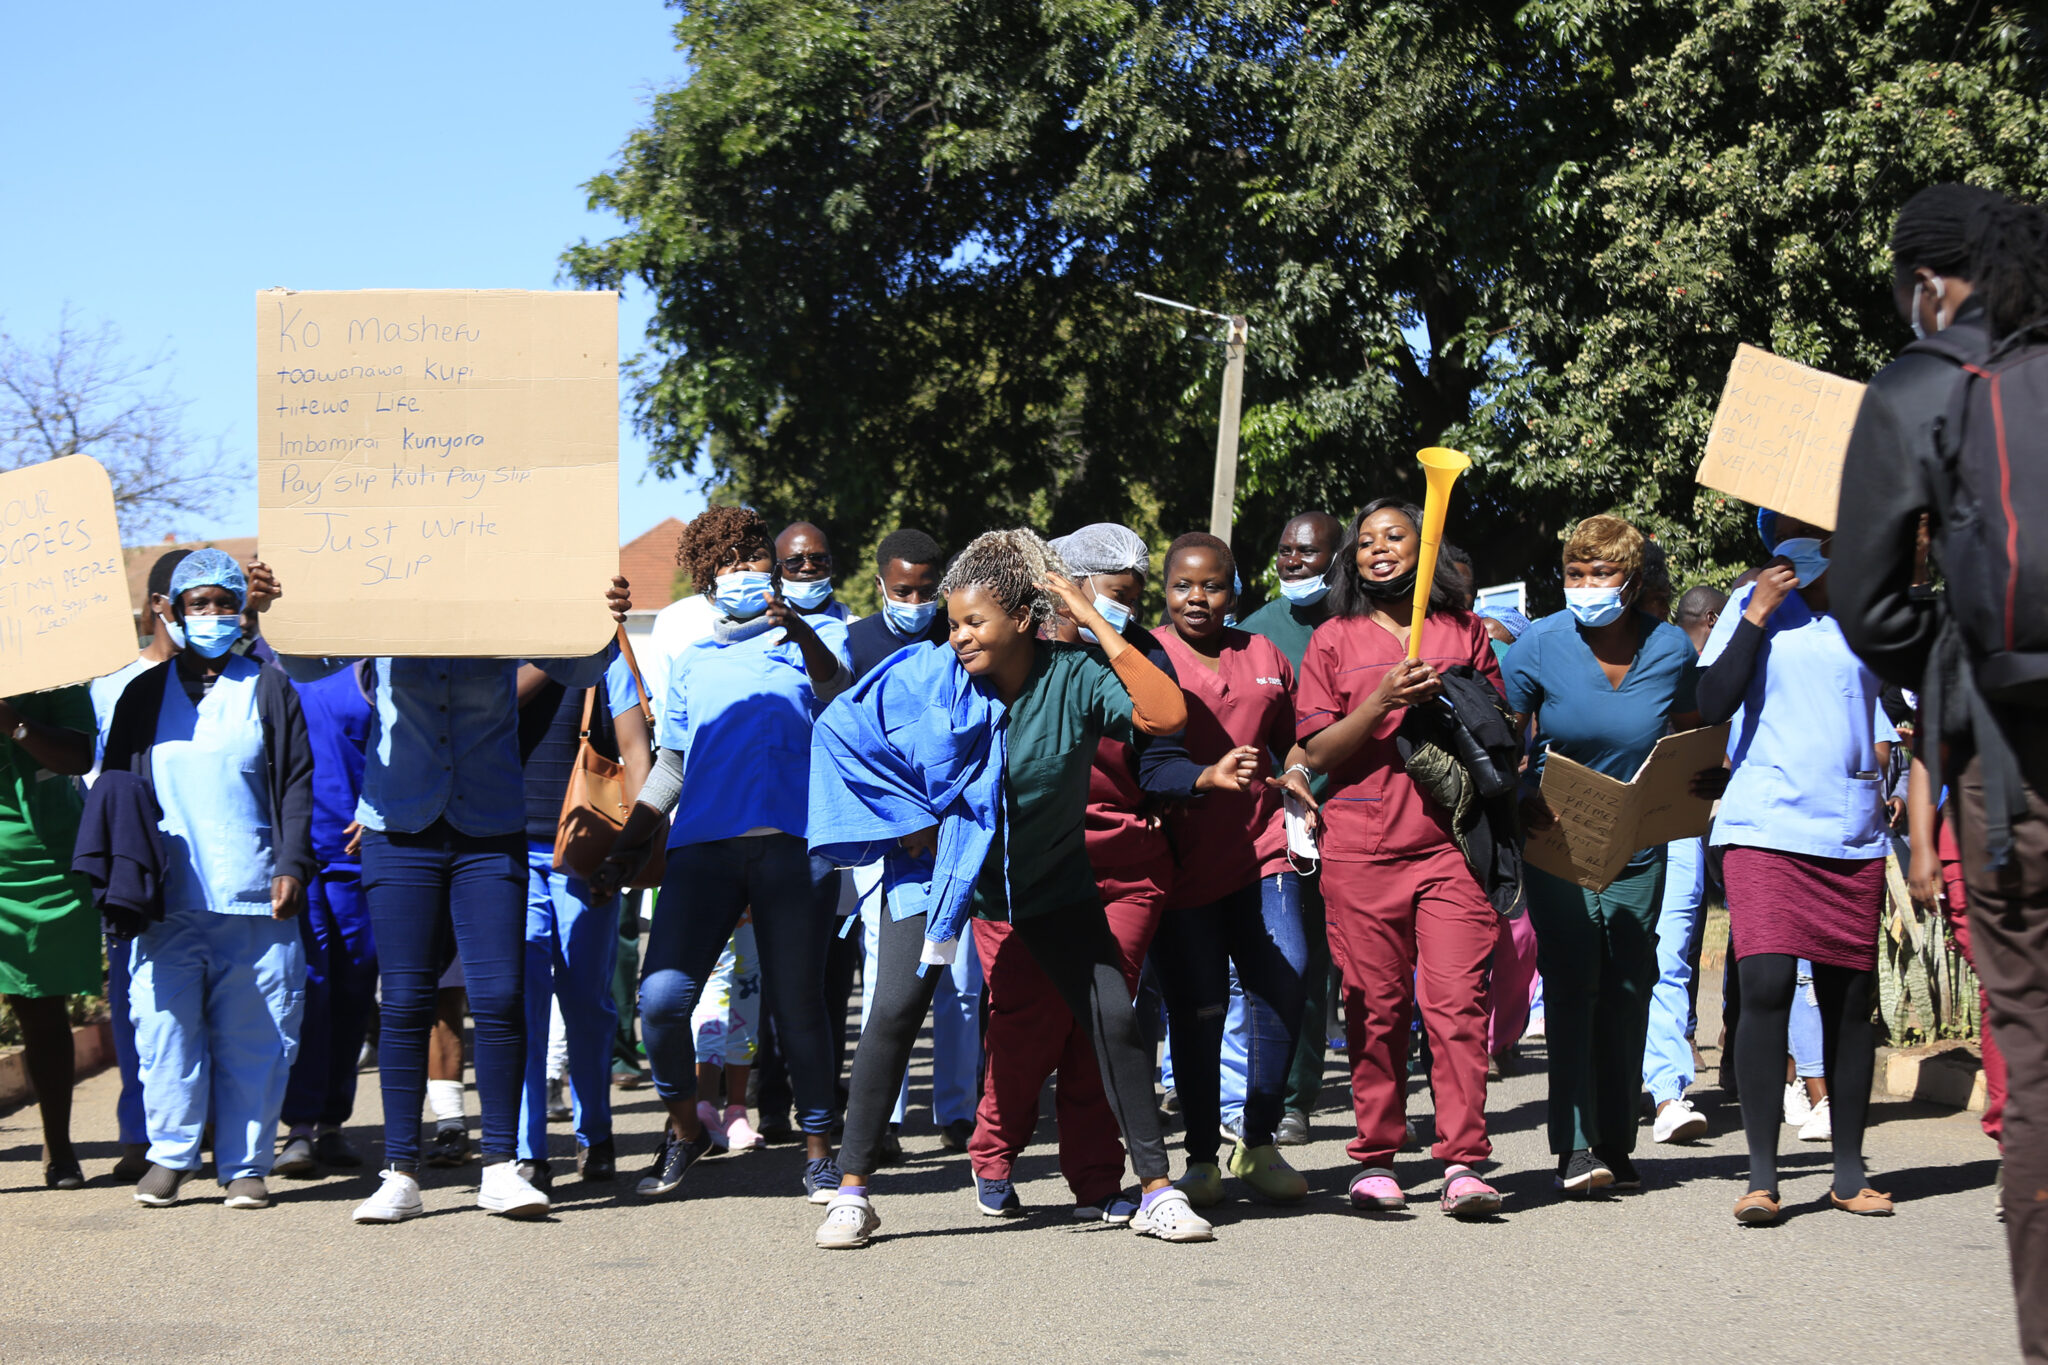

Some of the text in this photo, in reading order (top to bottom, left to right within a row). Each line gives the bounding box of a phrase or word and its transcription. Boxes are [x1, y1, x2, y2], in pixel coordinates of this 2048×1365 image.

[281, 464, 322, 504] Pay
[0, 489, 56, 533] OUR
[297, 512, 400, 553] Just
[360, 554, 432, 585] SLIP
